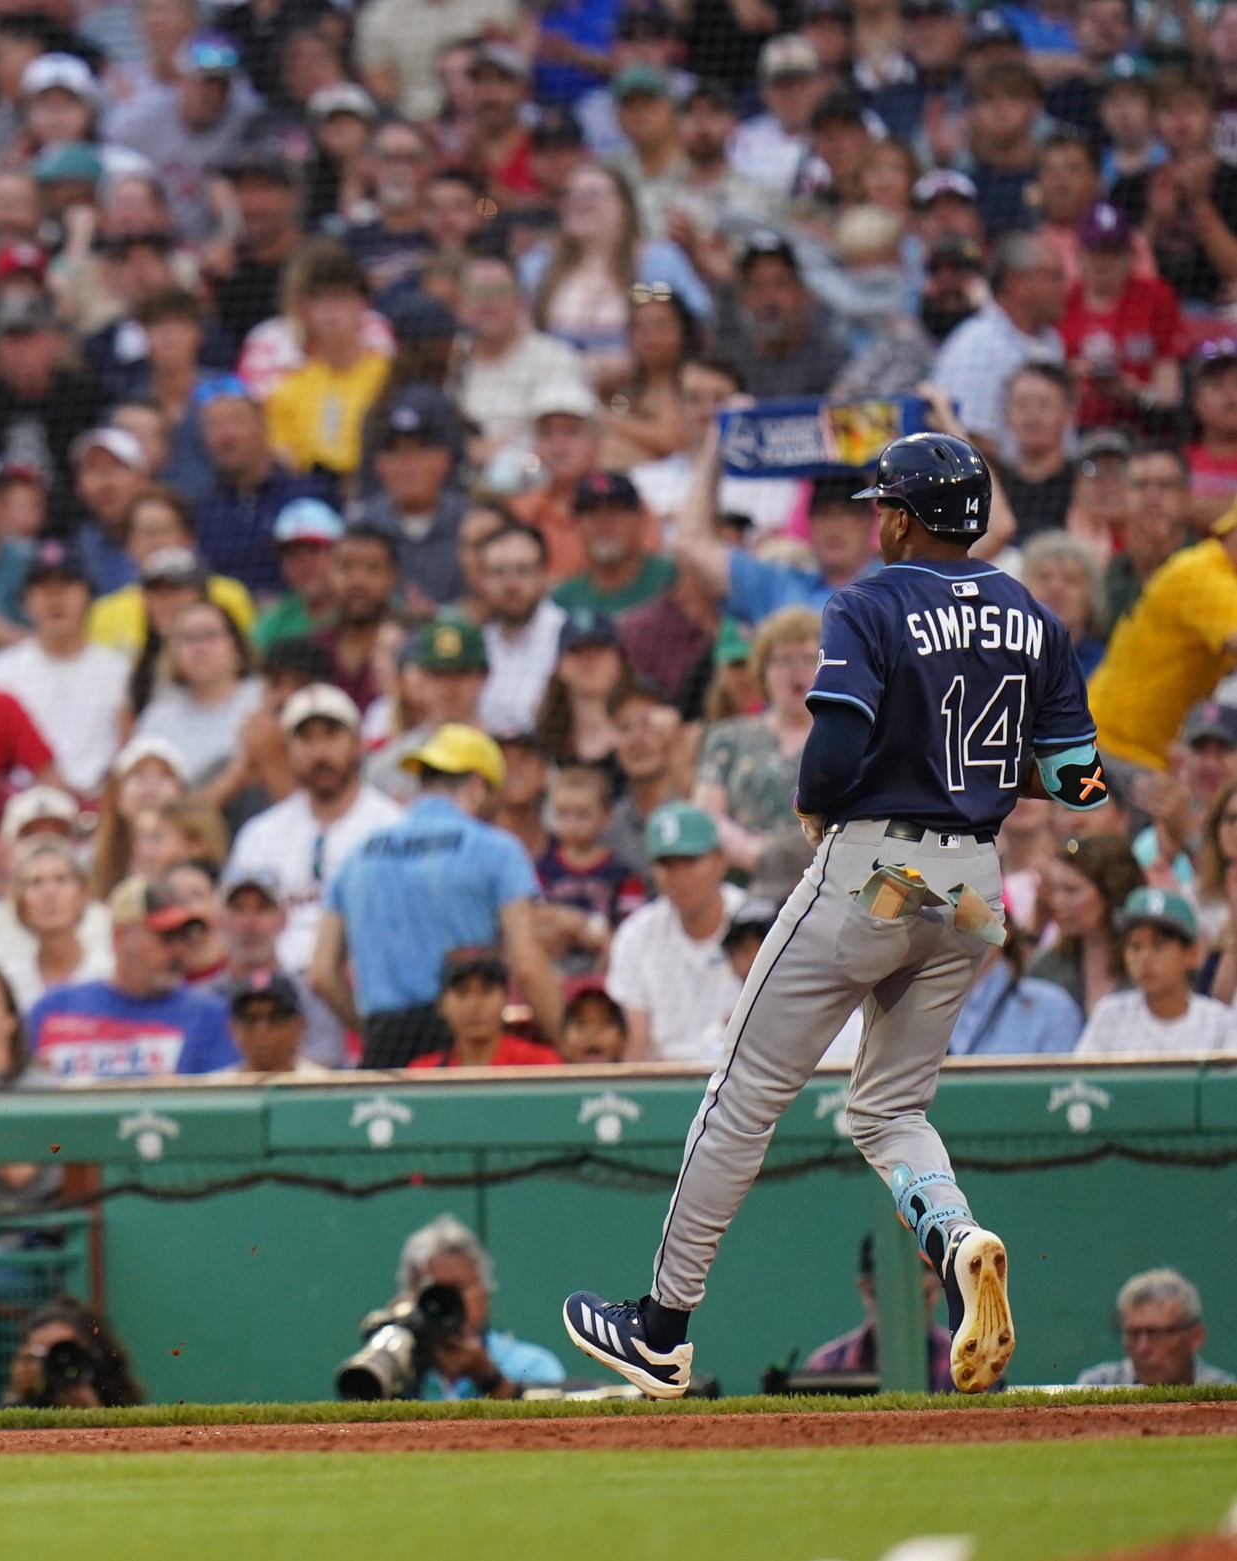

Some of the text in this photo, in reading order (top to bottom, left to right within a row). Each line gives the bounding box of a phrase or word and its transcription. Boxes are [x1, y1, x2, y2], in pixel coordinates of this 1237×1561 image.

[965, 497, 979, 514] 14
[906, 605, 1043, 660] SIMPSON
[940, 674, 1026, 792] 14
